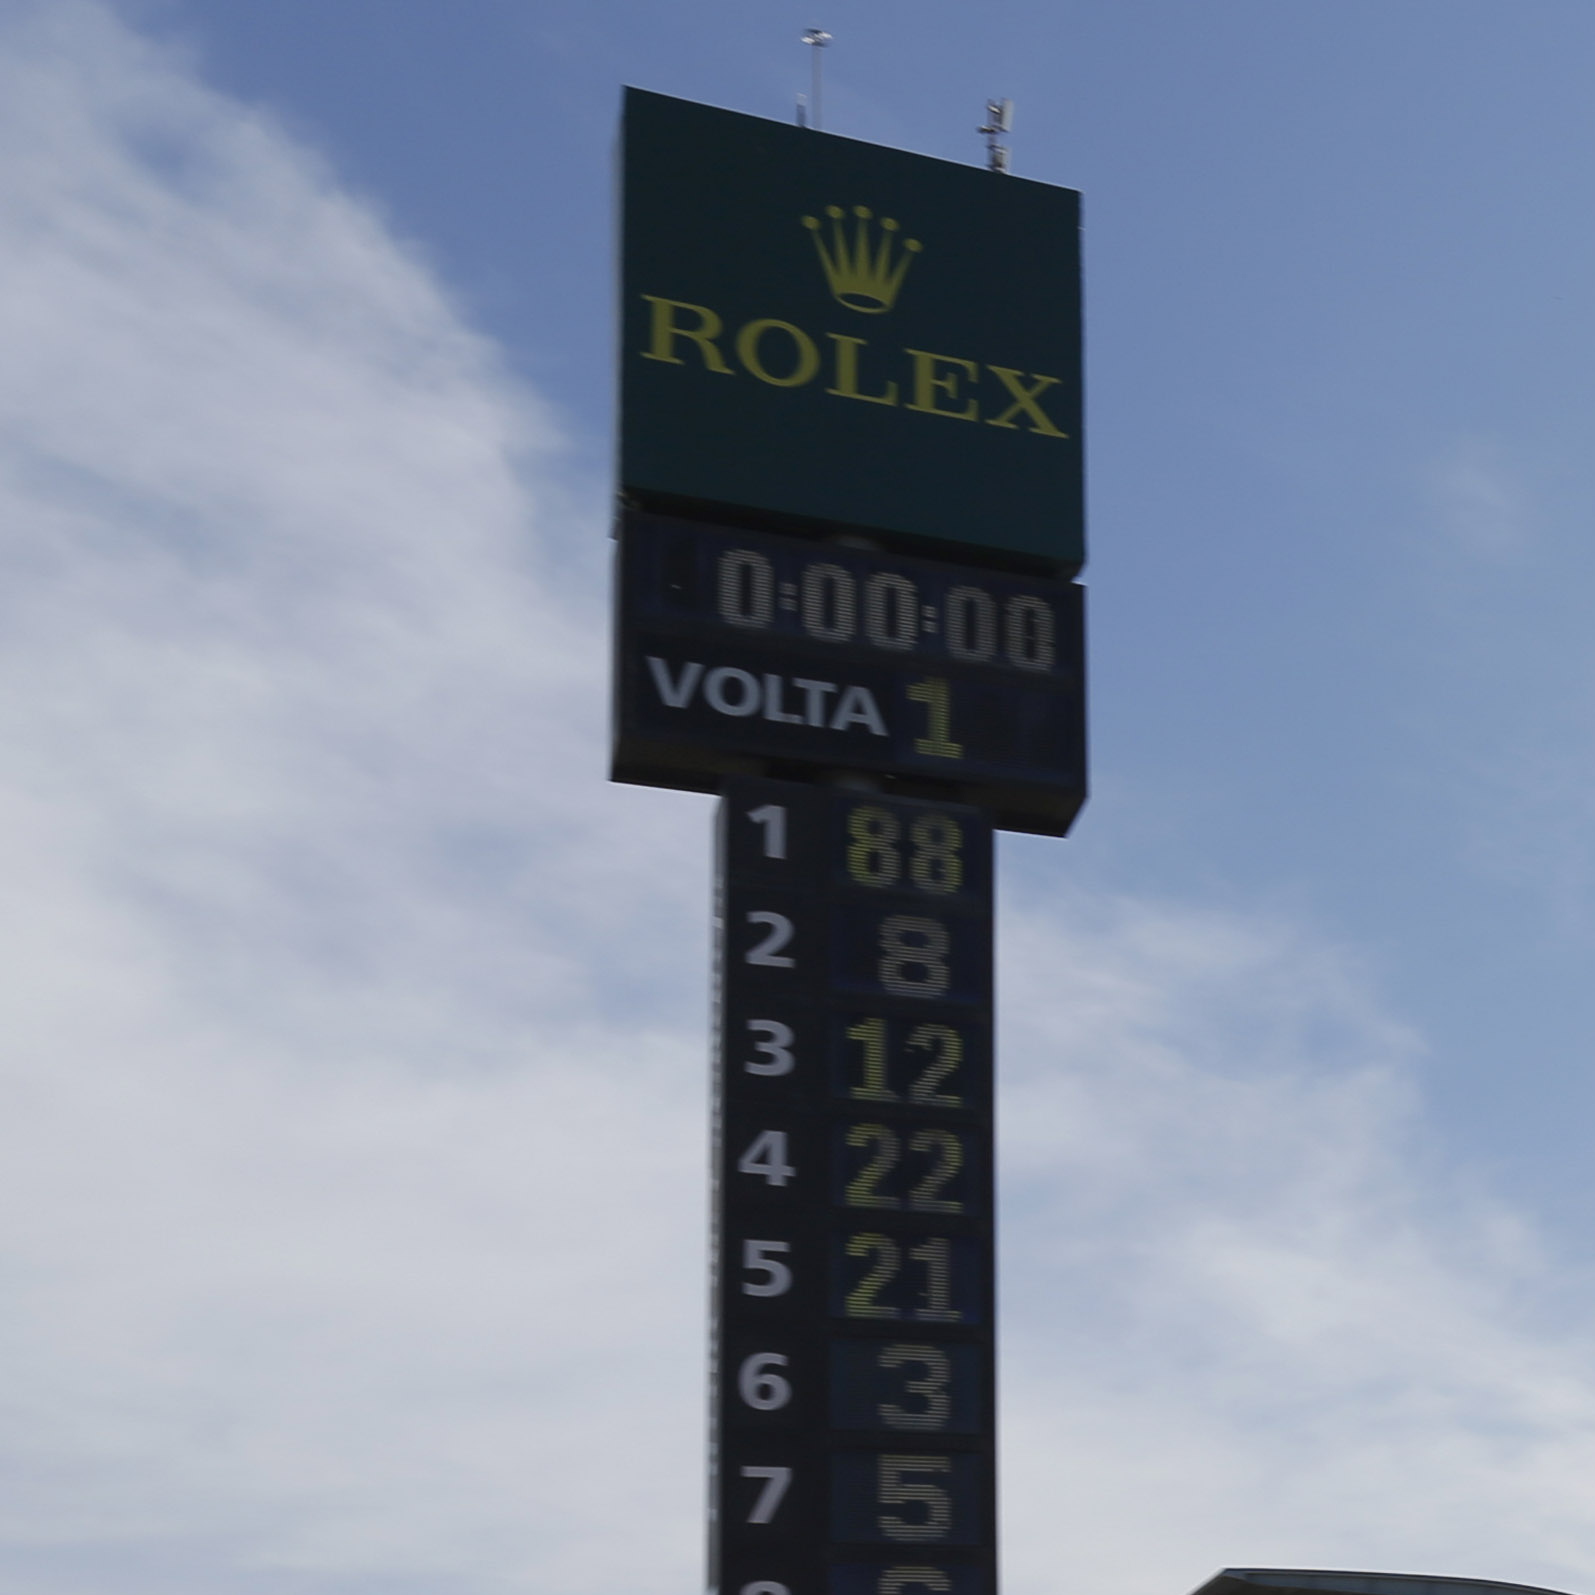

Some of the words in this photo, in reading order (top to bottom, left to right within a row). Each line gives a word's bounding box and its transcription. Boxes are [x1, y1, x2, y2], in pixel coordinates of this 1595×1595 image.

[640, 294, 1069, 439] ROLEX
[718, 548, 1056, 673] 0:00:00
[646, 655, 888, 737] VOLTA
[908, 677, 963, 759] 1
[748, 804, 787, 860] 1
[847, 804, 963, 895] 88
[745, 911, 795, 968] 2
[879, 914, 951, 999] 8
[744, 1019, 795, 1076] 3
[846, 1017, 963, 1107] 12
[738, 1130, 796, 1187] 4
[845, 1123, 963, 1213] 22
[742, 1239, 793, 1297] 5
[845, 1233, 963, 1322] 21
[738, 1352, 793, 1411] 6
[878, 1344, 951, 1431] 3
[740, 1466, 793, 1524] 7
[878, 1454, 952, 1541] 5
